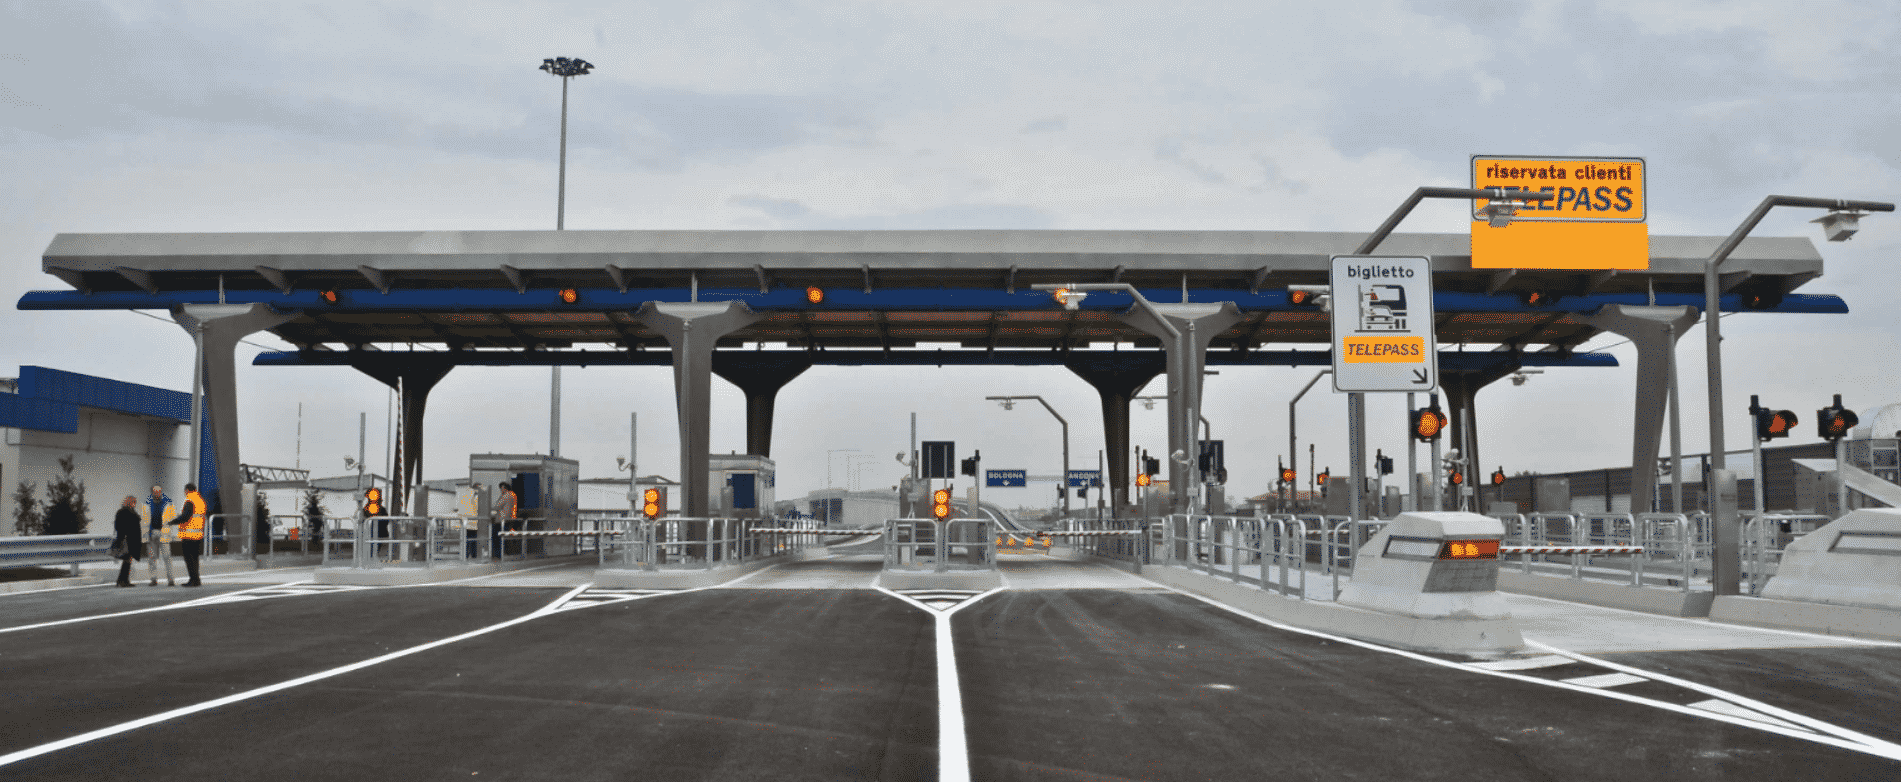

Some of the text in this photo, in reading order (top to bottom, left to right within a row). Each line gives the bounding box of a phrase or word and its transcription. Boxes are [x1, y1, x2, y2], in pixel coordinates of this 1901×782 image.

[1486, 163, 1632, 180] riservata clienti
[1484, 186, 1633, 212] LEPASS
[1347, 265, 1414, 280] biglietto
[1348, 343, 1420, 356] TELEPASS
